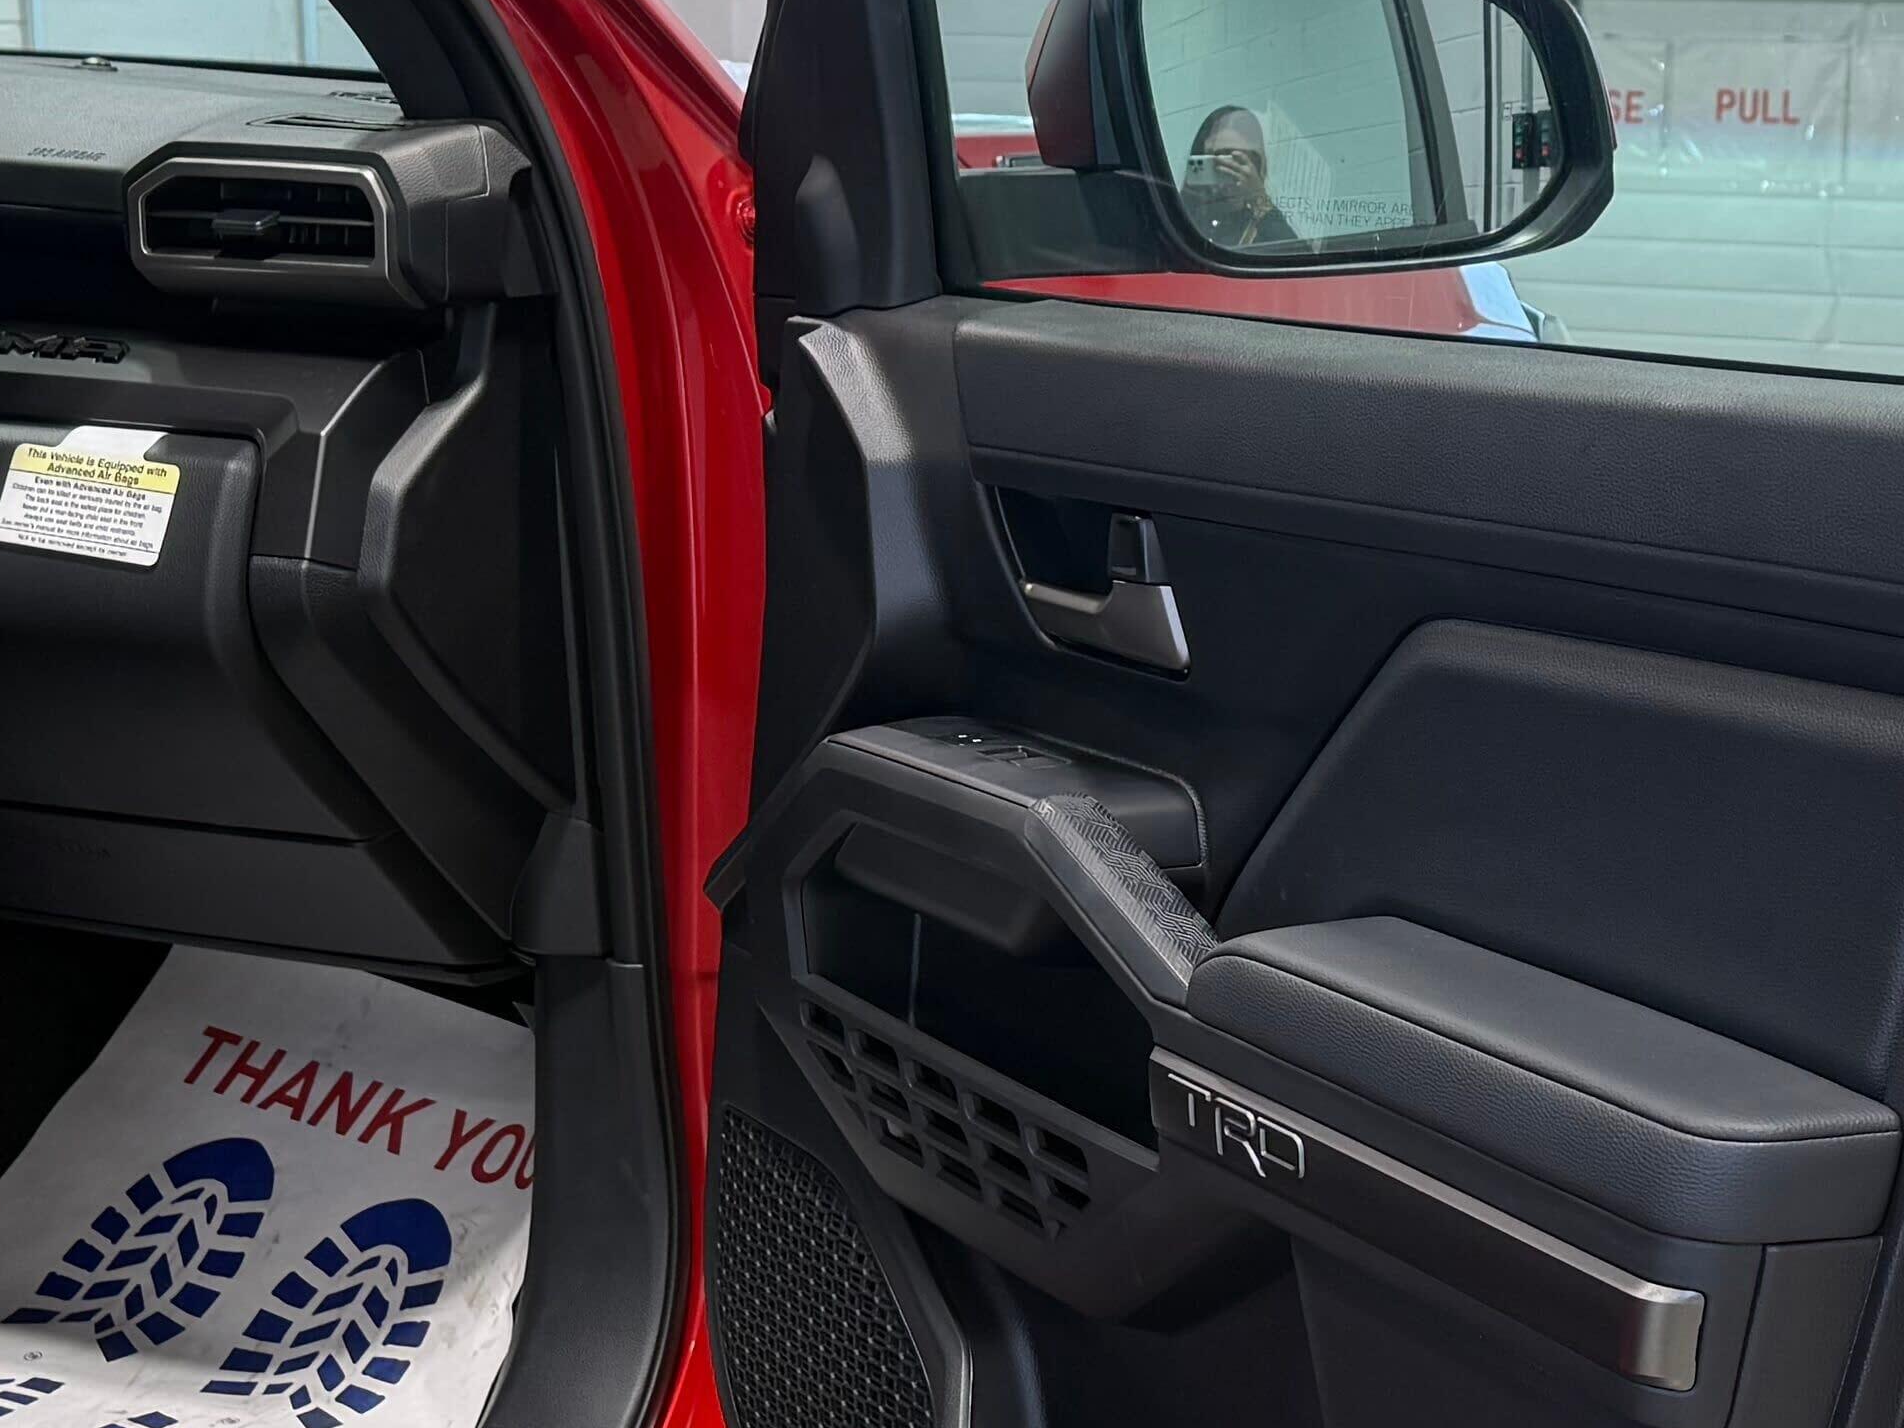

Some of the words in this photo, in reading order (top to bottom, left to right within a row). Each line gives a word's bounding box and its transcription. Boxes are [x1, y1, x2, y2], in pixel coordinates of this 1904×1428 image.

[1608, 88, 1645, 125] SE
[1715, 88, 1801, 125] PULL
[1333, 198, 1387, 213] MIRROR
[1337, 213, 1370, 227] THEY
[28, 447, 47, 459] This
[51, 451, 84, 465] Vehicle
[86, 456, 95, 466] is
[97, 458, 144, 474] Equipped
[147, 467, 167, 478] with
[47, 462, 96, 478] Advanced
[97, 470, 112, 480] Air
[114, 472, 139, 487] Bags
[183, 1025, 437, 1156] THANK
[1168, 1072, 1306, 1179] TRD
